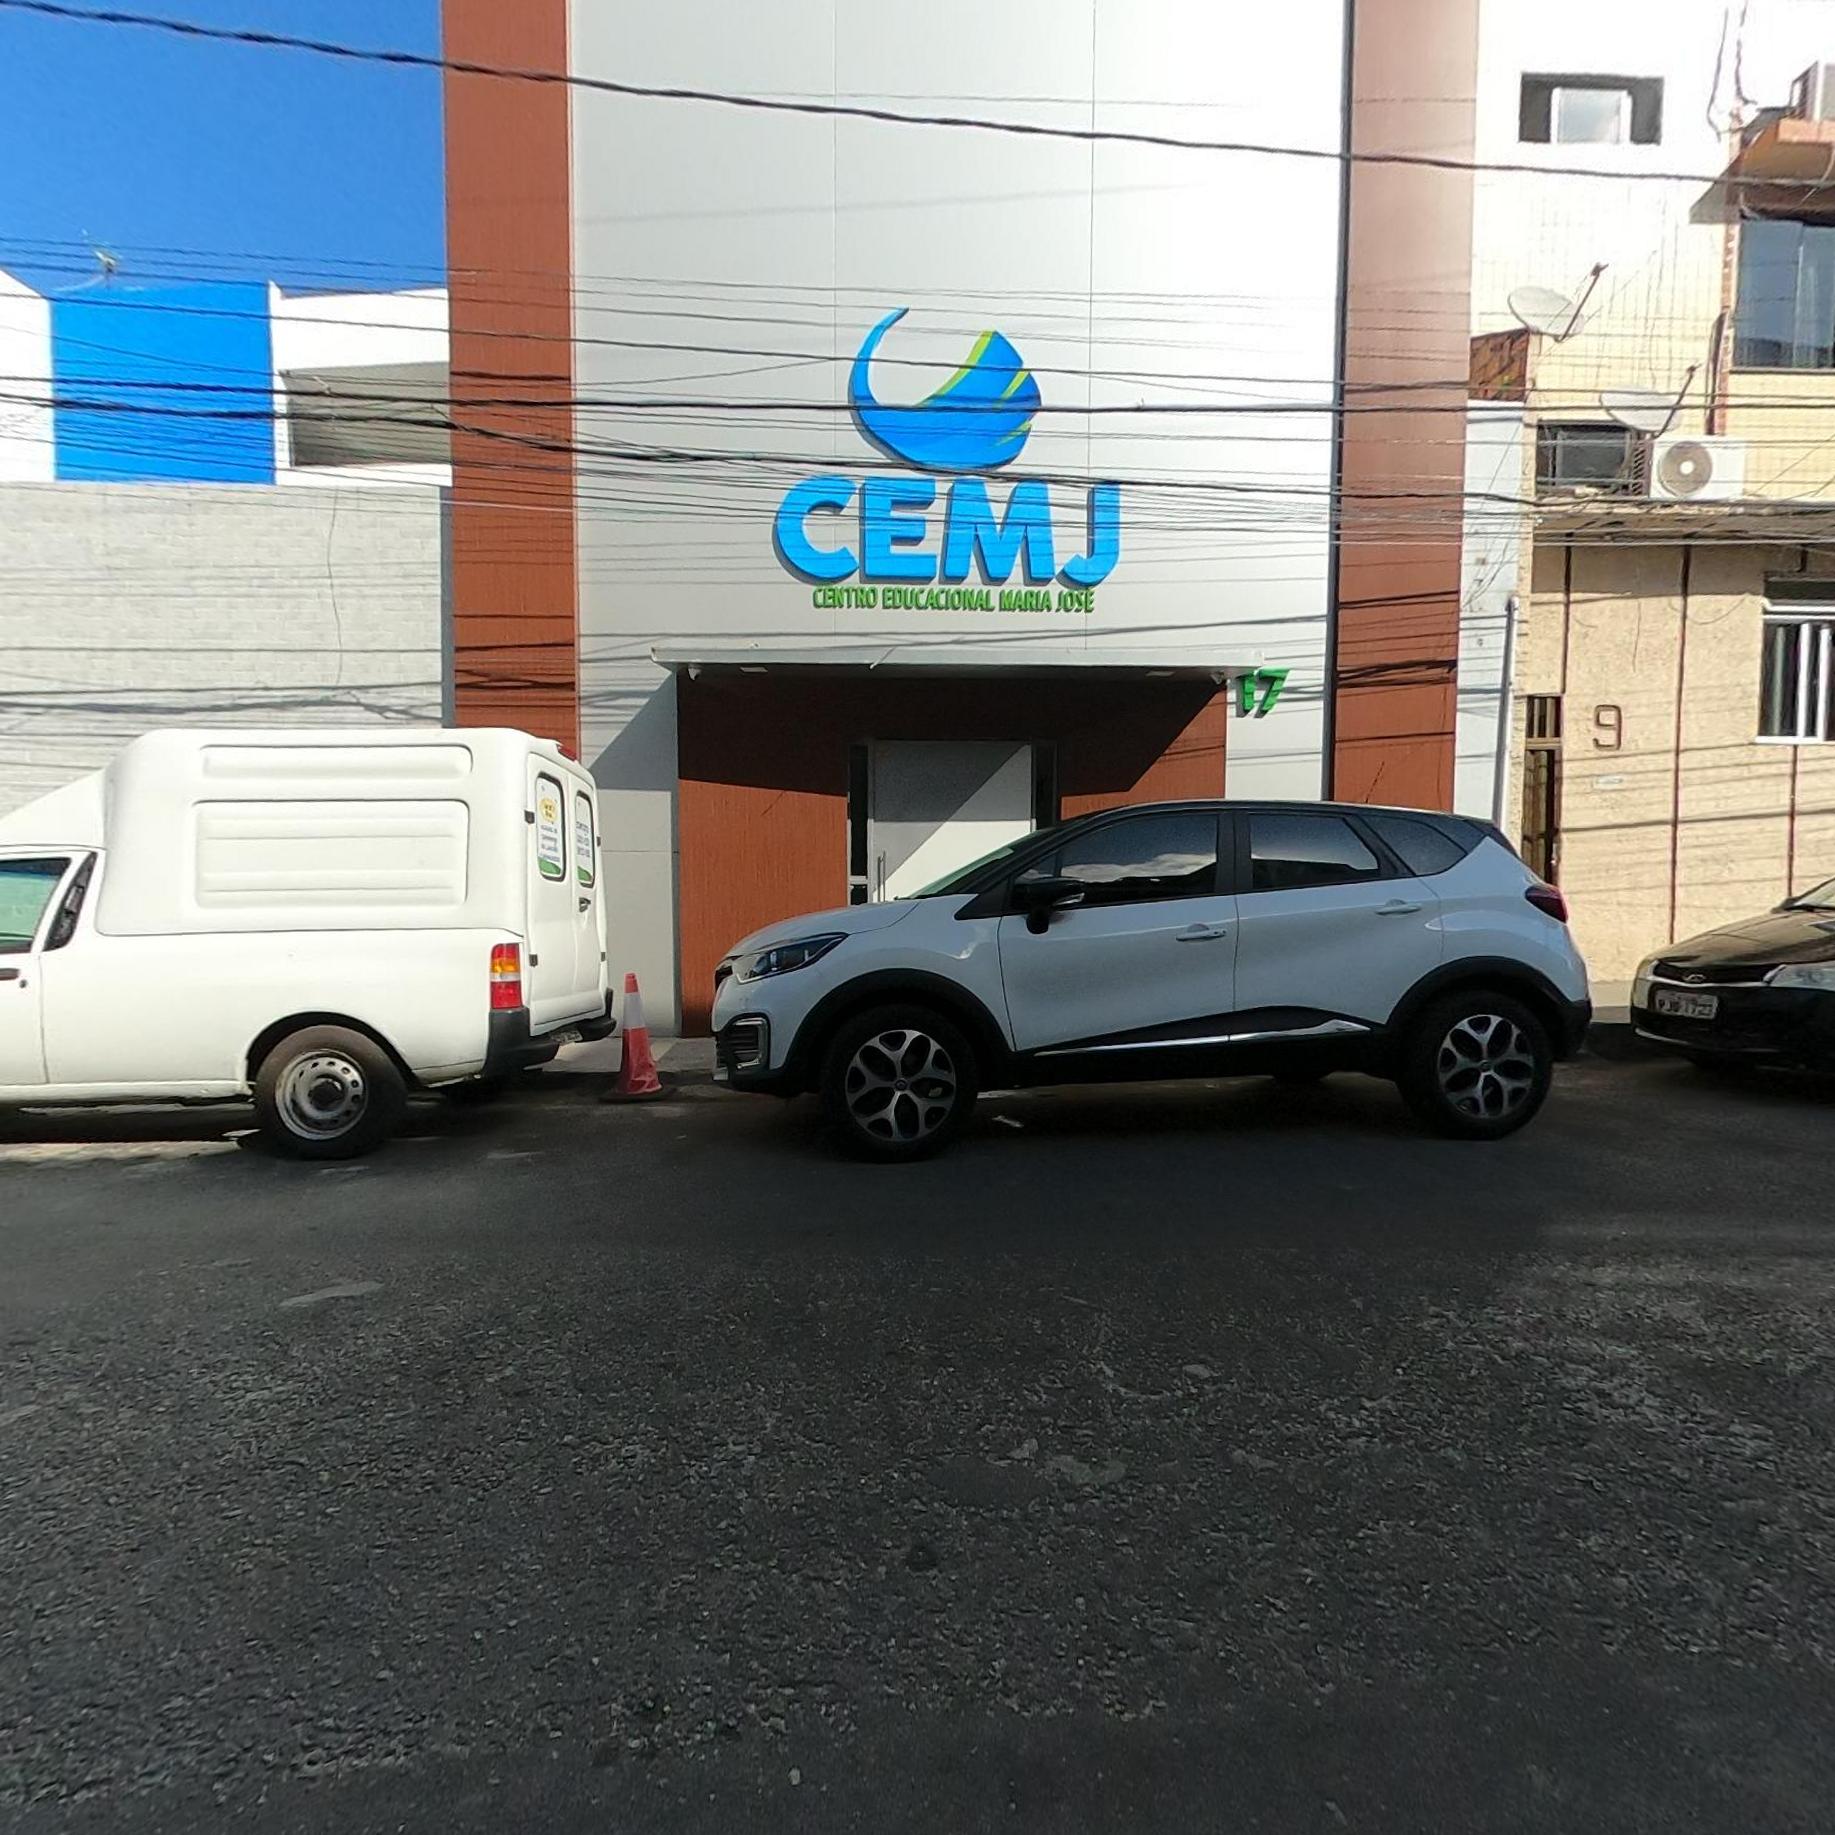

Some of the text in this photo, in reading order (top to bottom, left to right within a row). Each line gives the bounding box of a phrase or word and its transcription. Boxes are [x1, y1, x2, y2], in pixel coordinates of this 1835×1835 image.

[774, 475, 1121, 586] CEMJ
[812, 586, 878, 609] CENTRO
[882, 587, 995, 611] EDUCACIONAL
[999, 588, 1052, 612] MARIA
[1237, 666, 1290, 717] 17
[1593, 704, 1622, 752] 9
